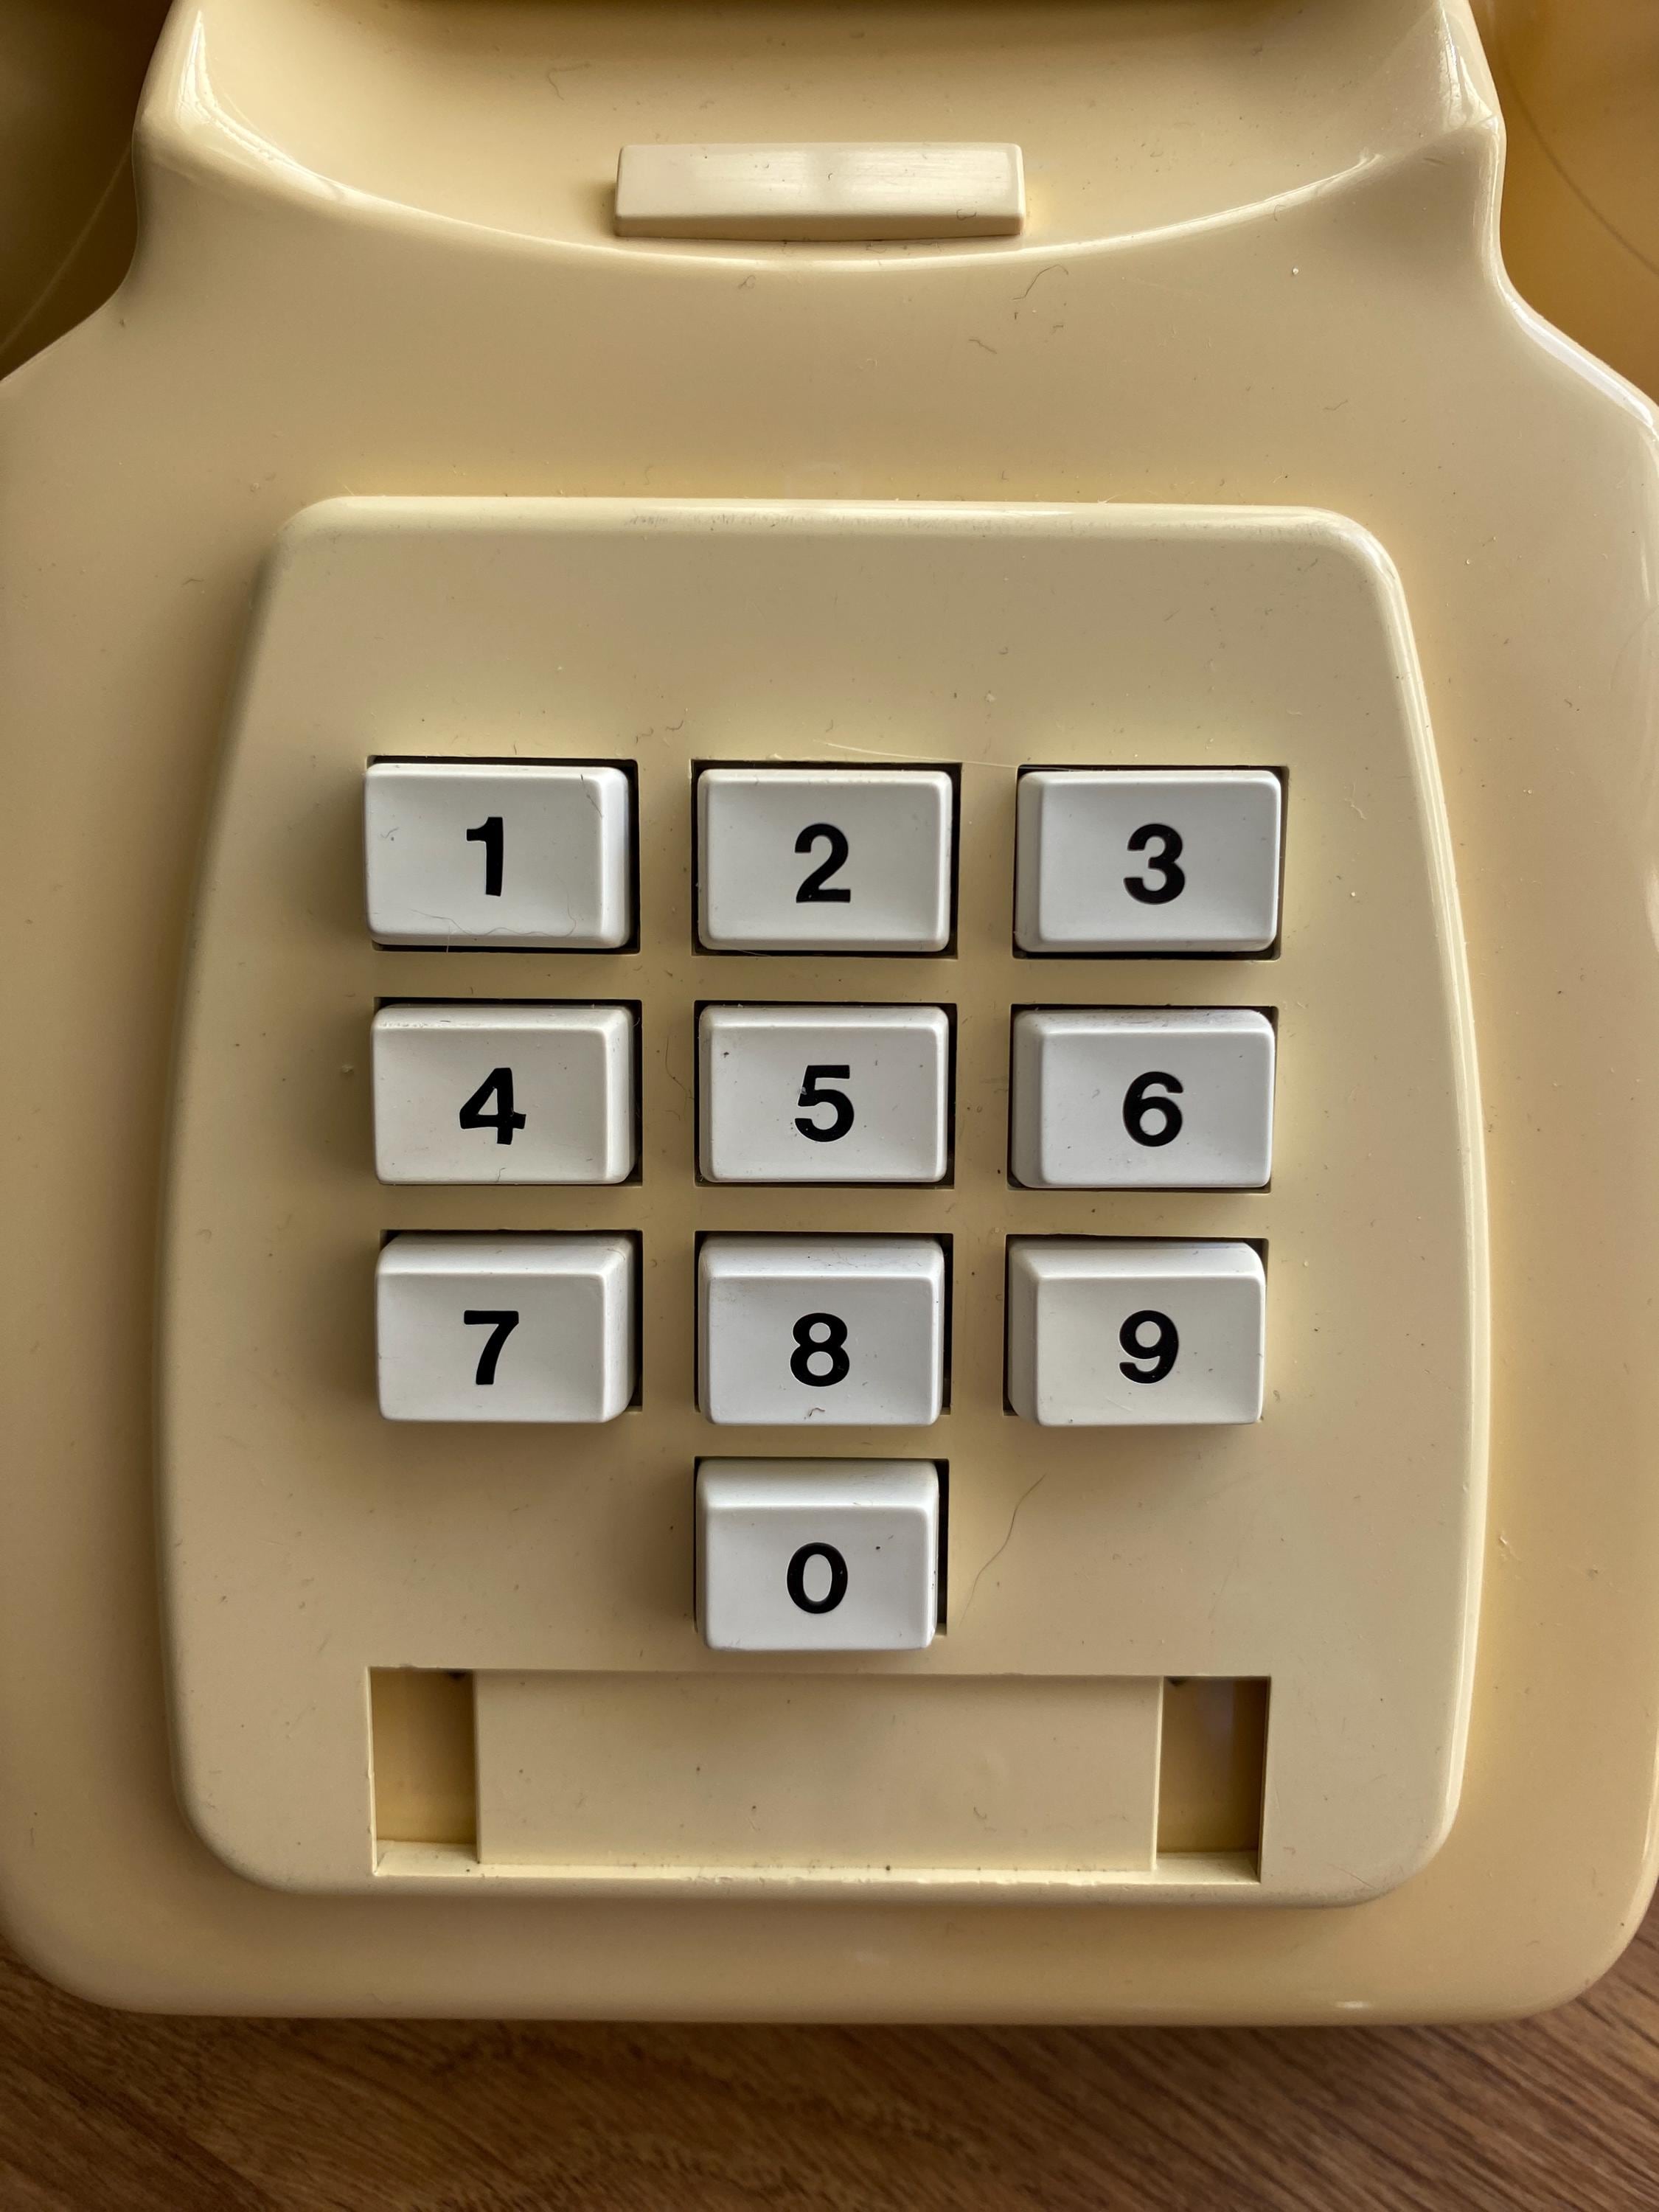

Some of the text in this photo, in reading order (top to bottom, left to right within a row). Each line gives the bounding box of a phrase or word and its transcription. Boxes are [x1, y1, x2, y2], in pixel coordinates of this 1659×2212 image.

[466, 817, 504, 897] 1
[794, 822, 852, 903] 2
[1123, 823, 1186, 905] 3
[459, 1067, 526, 1146] 4
[794, 1064, 855, 1143] 5
[1122, 1071, 1184, 1147] 6
[463, 1310, 520, 1385] 7
[790, 1312, 850, 1388] 8
[1119, 1310, 1180, 1384] 9
[786, 1542, 849, 1615] 0
